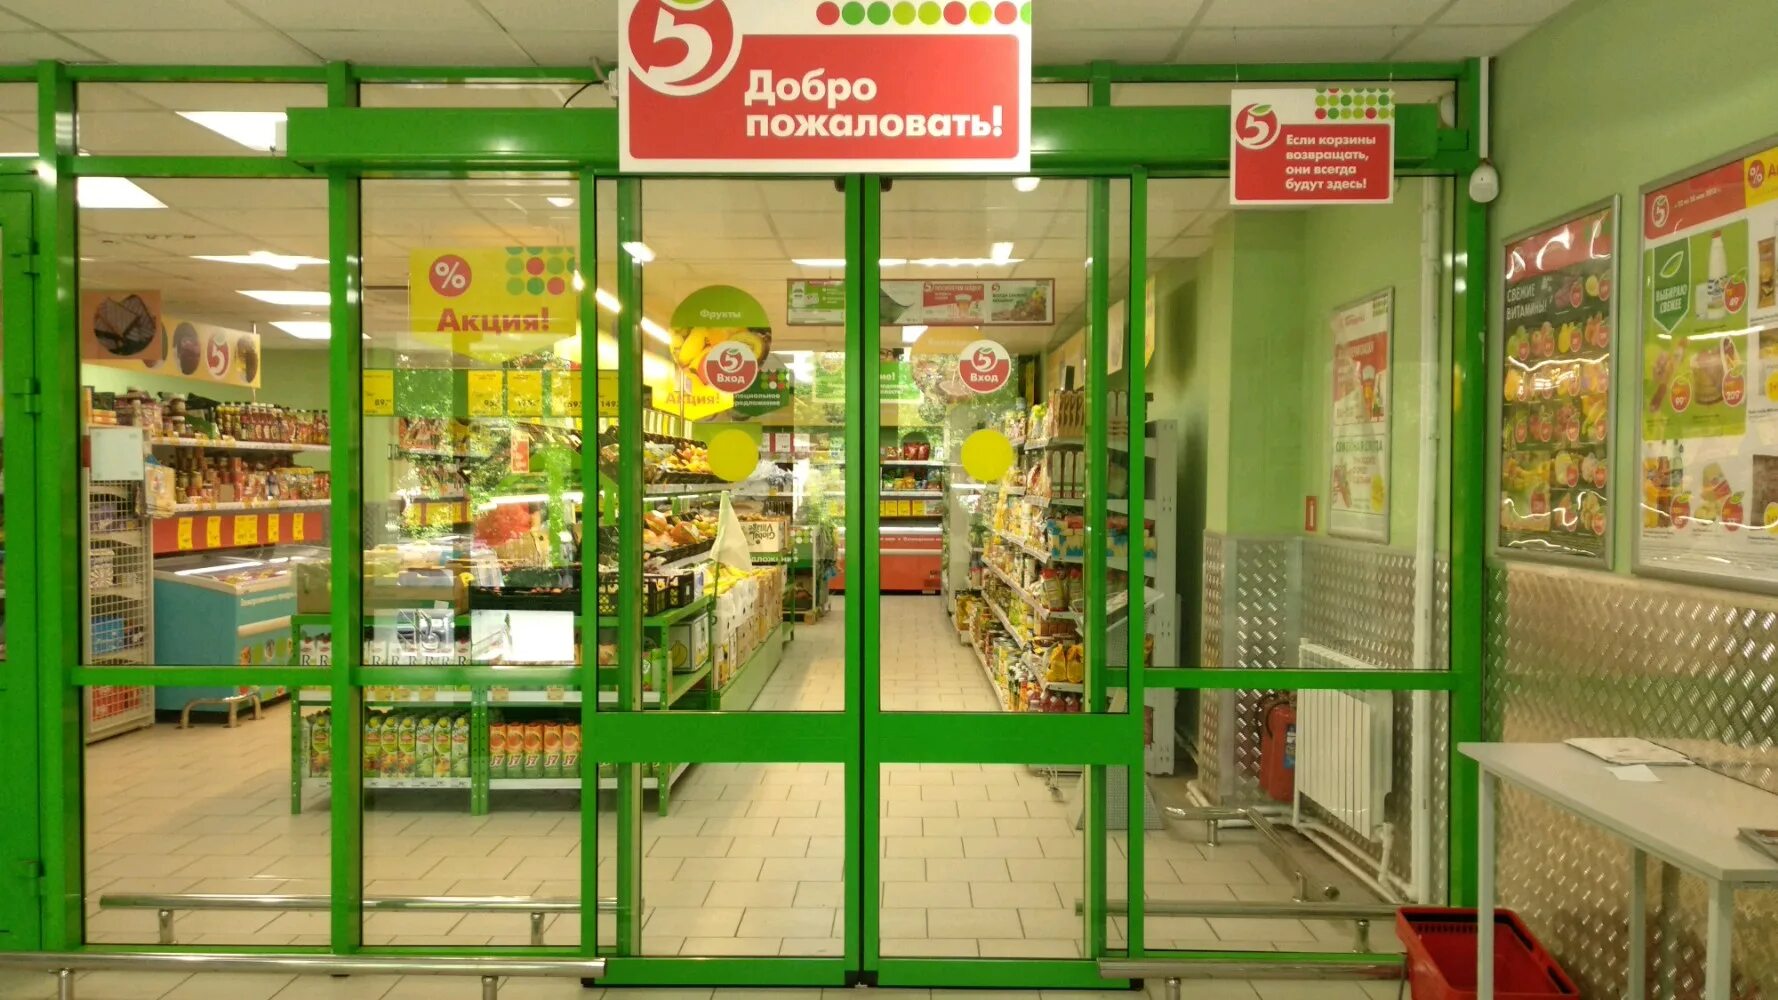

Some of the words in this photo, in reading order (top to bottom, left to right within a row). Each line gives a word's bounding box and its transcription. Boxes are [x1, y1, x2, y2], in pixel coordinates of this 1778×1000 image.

[744, 68, 878, 109] Добро
[746, 105, 1003, 138] пожаловать!
[1286, 134, 1316, 146] Если
[1318, 135, 1377, 148] корзины
[1286, 151, 1369, 162] возвращать,
[1286, 165, 1311, 175] они
[1314, 165, 1357, 176] всегда
[1285, 178, 1324, 192] будут
[1326, 177, 1368, 190] здесь!
[436, 307, 550, 335] Акция!
[700, 309, 741, 320] Фрукты
[716, 373, 746, 385] Вход
[970, 373, 999, 384] Вход
